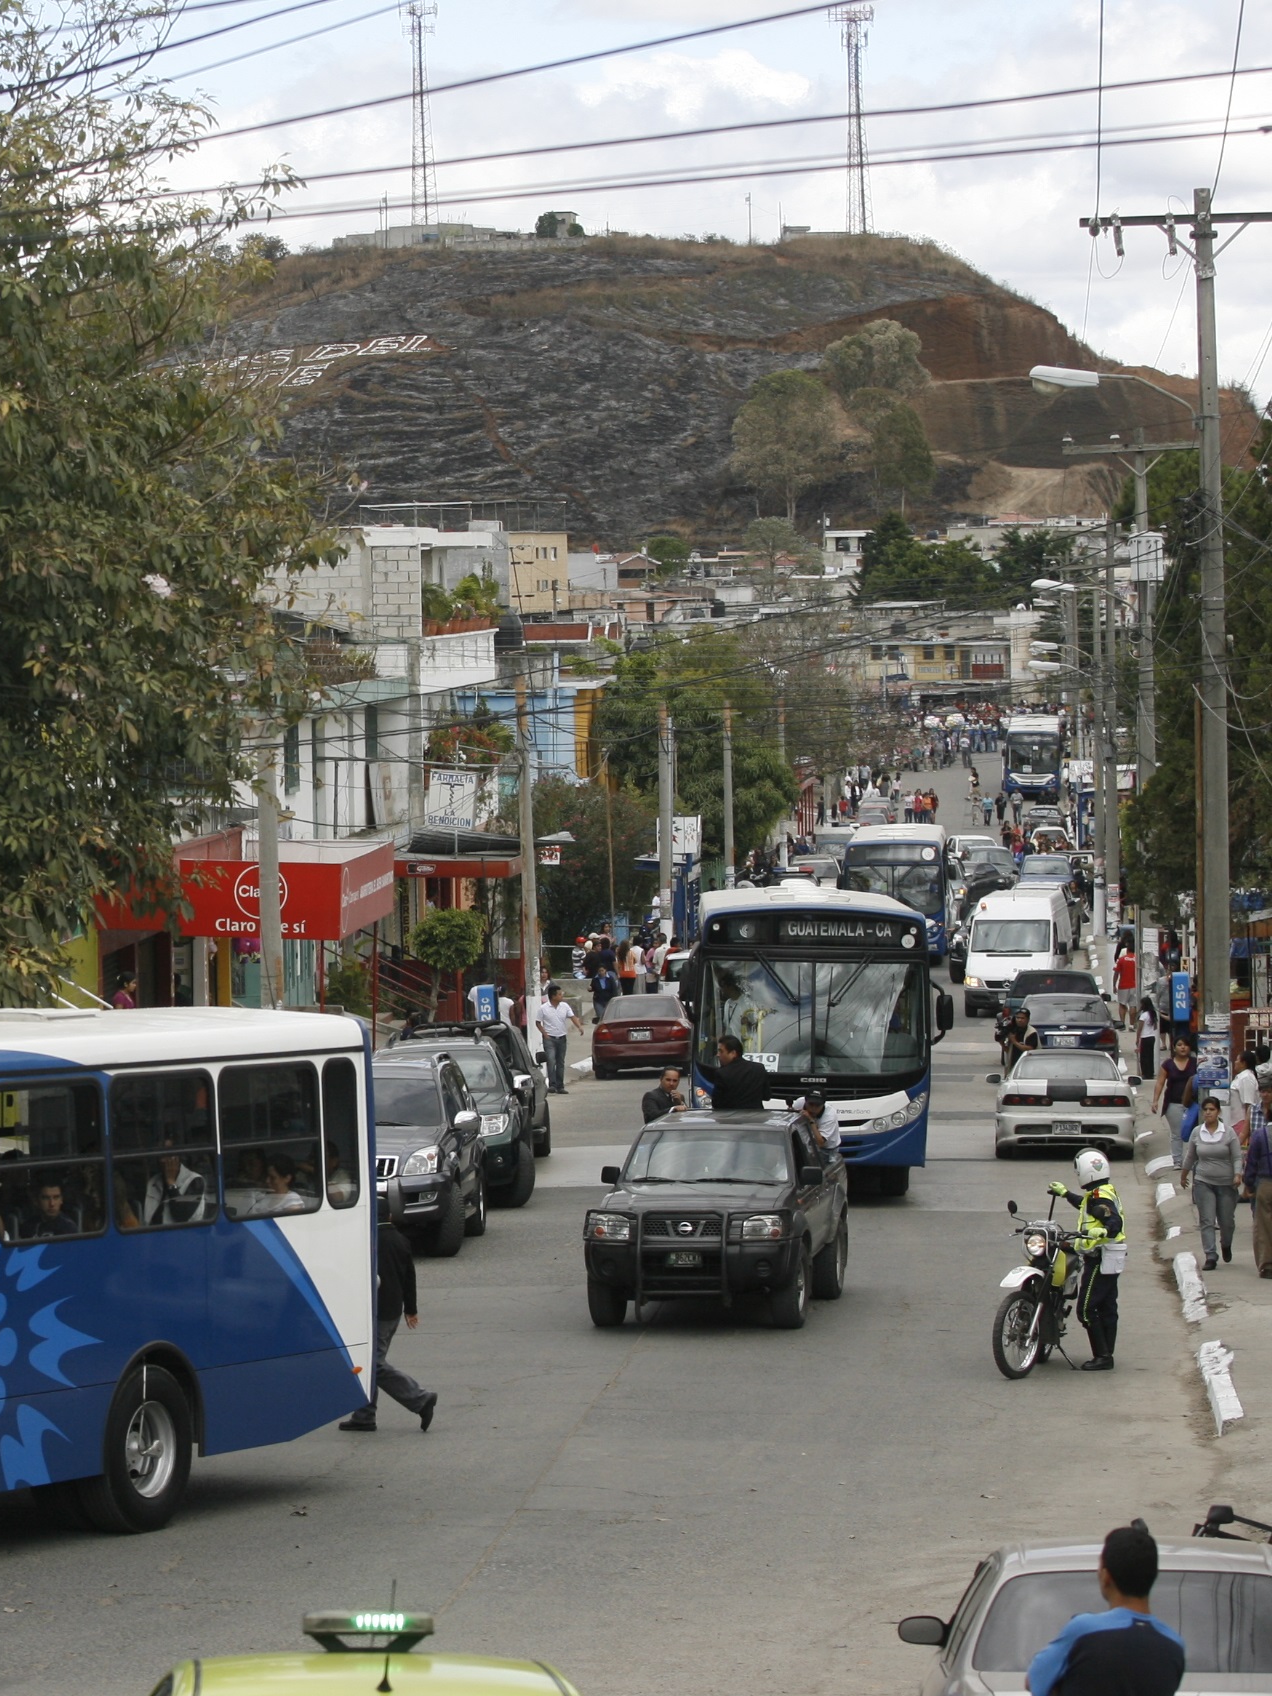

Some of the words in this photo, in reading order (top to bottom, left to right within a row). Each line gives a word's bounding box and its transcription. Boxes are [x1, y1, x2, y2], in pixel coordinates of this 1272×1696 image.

[431, 772, 474, 784] FARMACIA
[427, 815, 471, 828] BENDICION
[215, 918, 256, 932] Claro
[293, 919, 306, 934] sí
[787, 920, 865, 937] GUATEMALA
[875, 921, 892, 937] CA
[744, 1054, 777, 1063] 310
